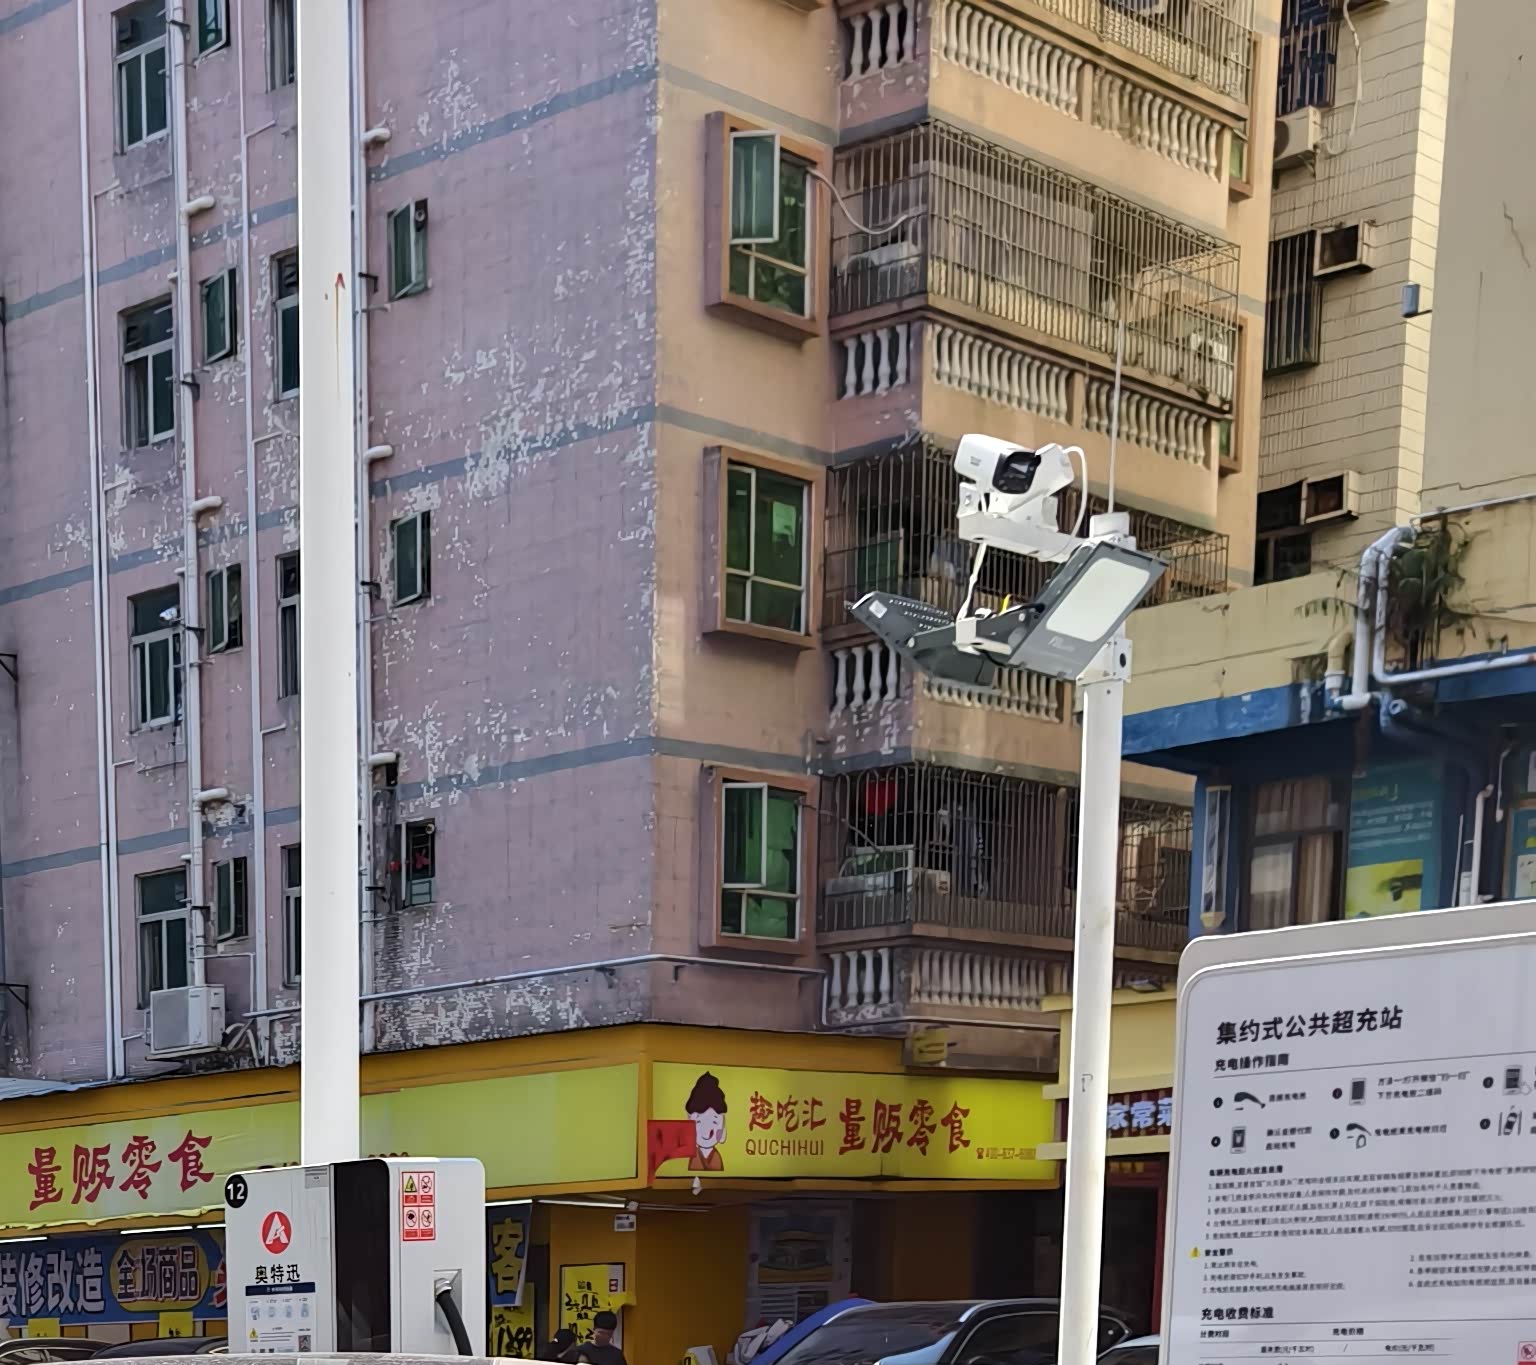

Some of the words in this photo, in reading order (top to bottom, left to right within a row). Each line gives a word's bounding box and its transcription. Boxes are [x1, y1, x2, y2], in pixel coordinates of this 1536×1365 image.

[1216, 1005, 1403, 1045] 集约式公共超充站
[838, 1098, 971, 1157] 量贩零食
[745, 1138, 825, 1157] QUCHIHUI
[27, 1128, 214, 1211] 量贩零食
[226, 1183, 245, 1201] 12
[115, 1240, 201, 1302] 全场商品
[254, 1263, 301, 1285] 奥特迅
[1201, 1306, 1274, 1321] 充电收费标准
